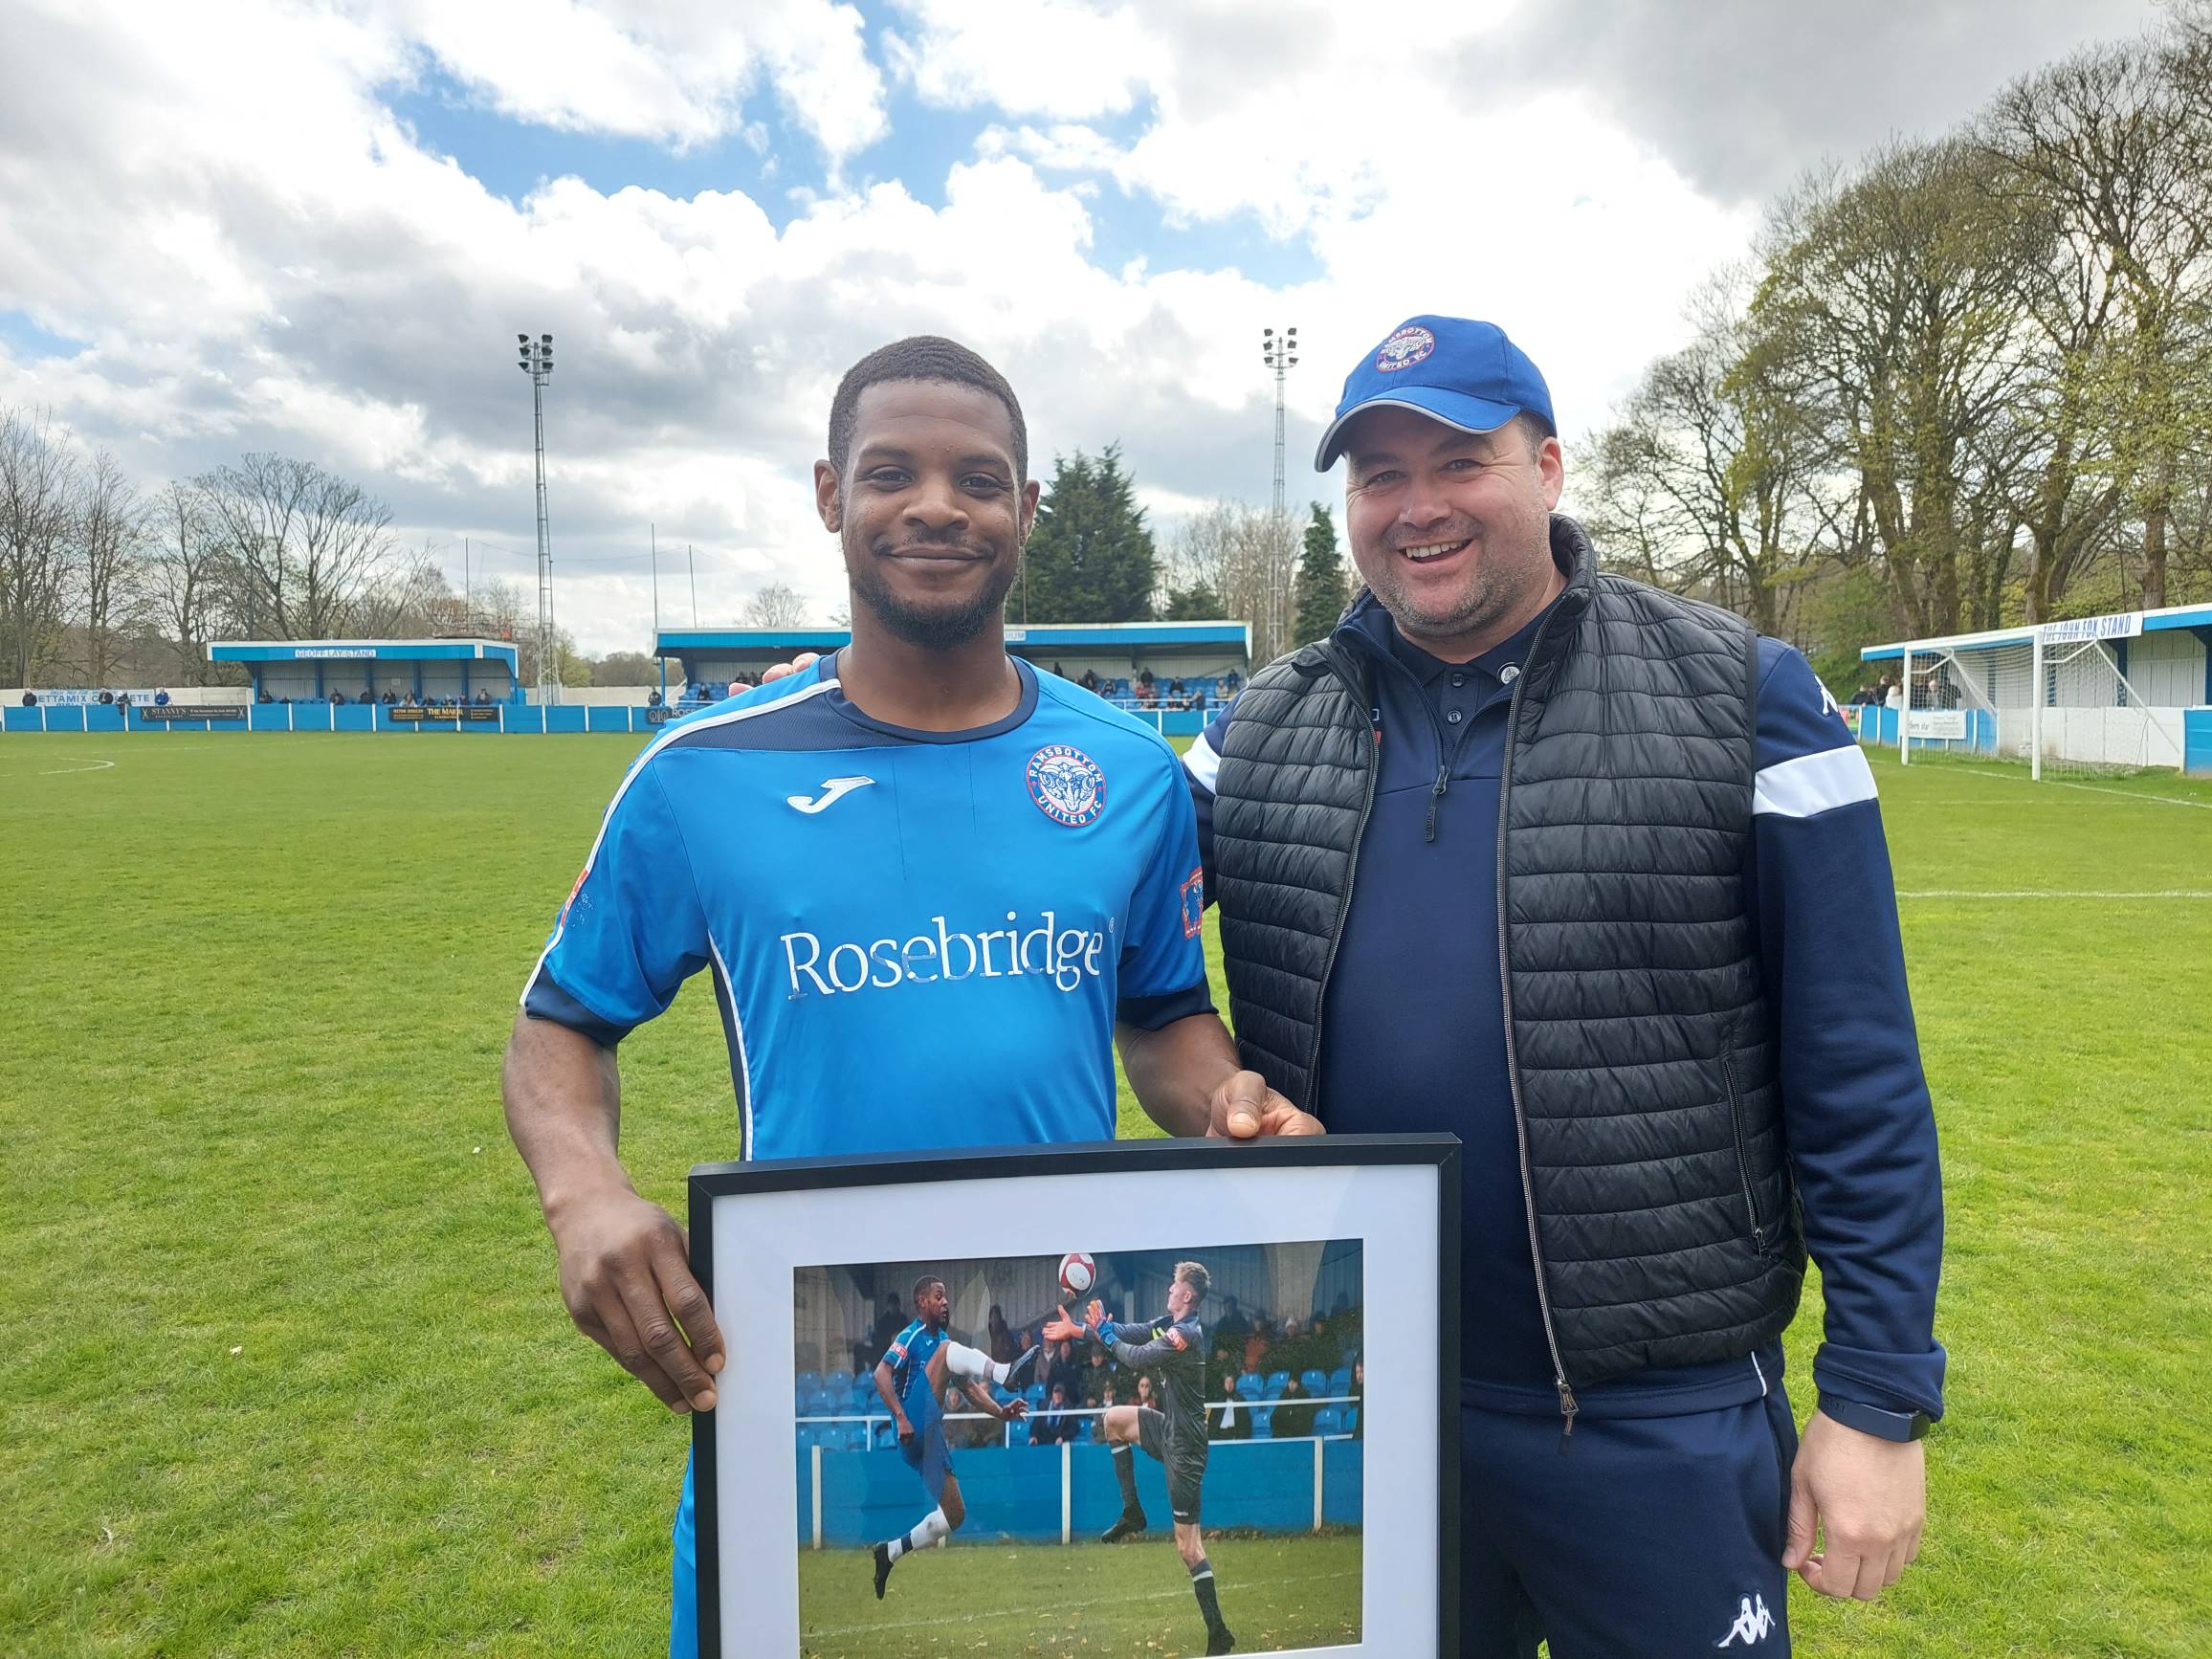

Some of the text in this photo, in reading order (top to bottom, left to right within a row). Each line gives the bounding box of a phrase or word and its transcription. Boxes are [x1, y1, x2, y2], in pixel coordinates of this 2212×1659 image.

[2043, 625, 2057, 643] THE
[2082, 618, 2099, 639] FOX
[2100, 614, 2132, 637] STAND
[345, 649, 374, 657] STAND
[38, 695, 150, 703] ETTAMIX CCETE
[1029, 746, 1103, 783] RAMSBOTTOM
[1038, 795, 1102, 824] UNITED FC
[780, 911, 1104, 1000] Rosebridge
